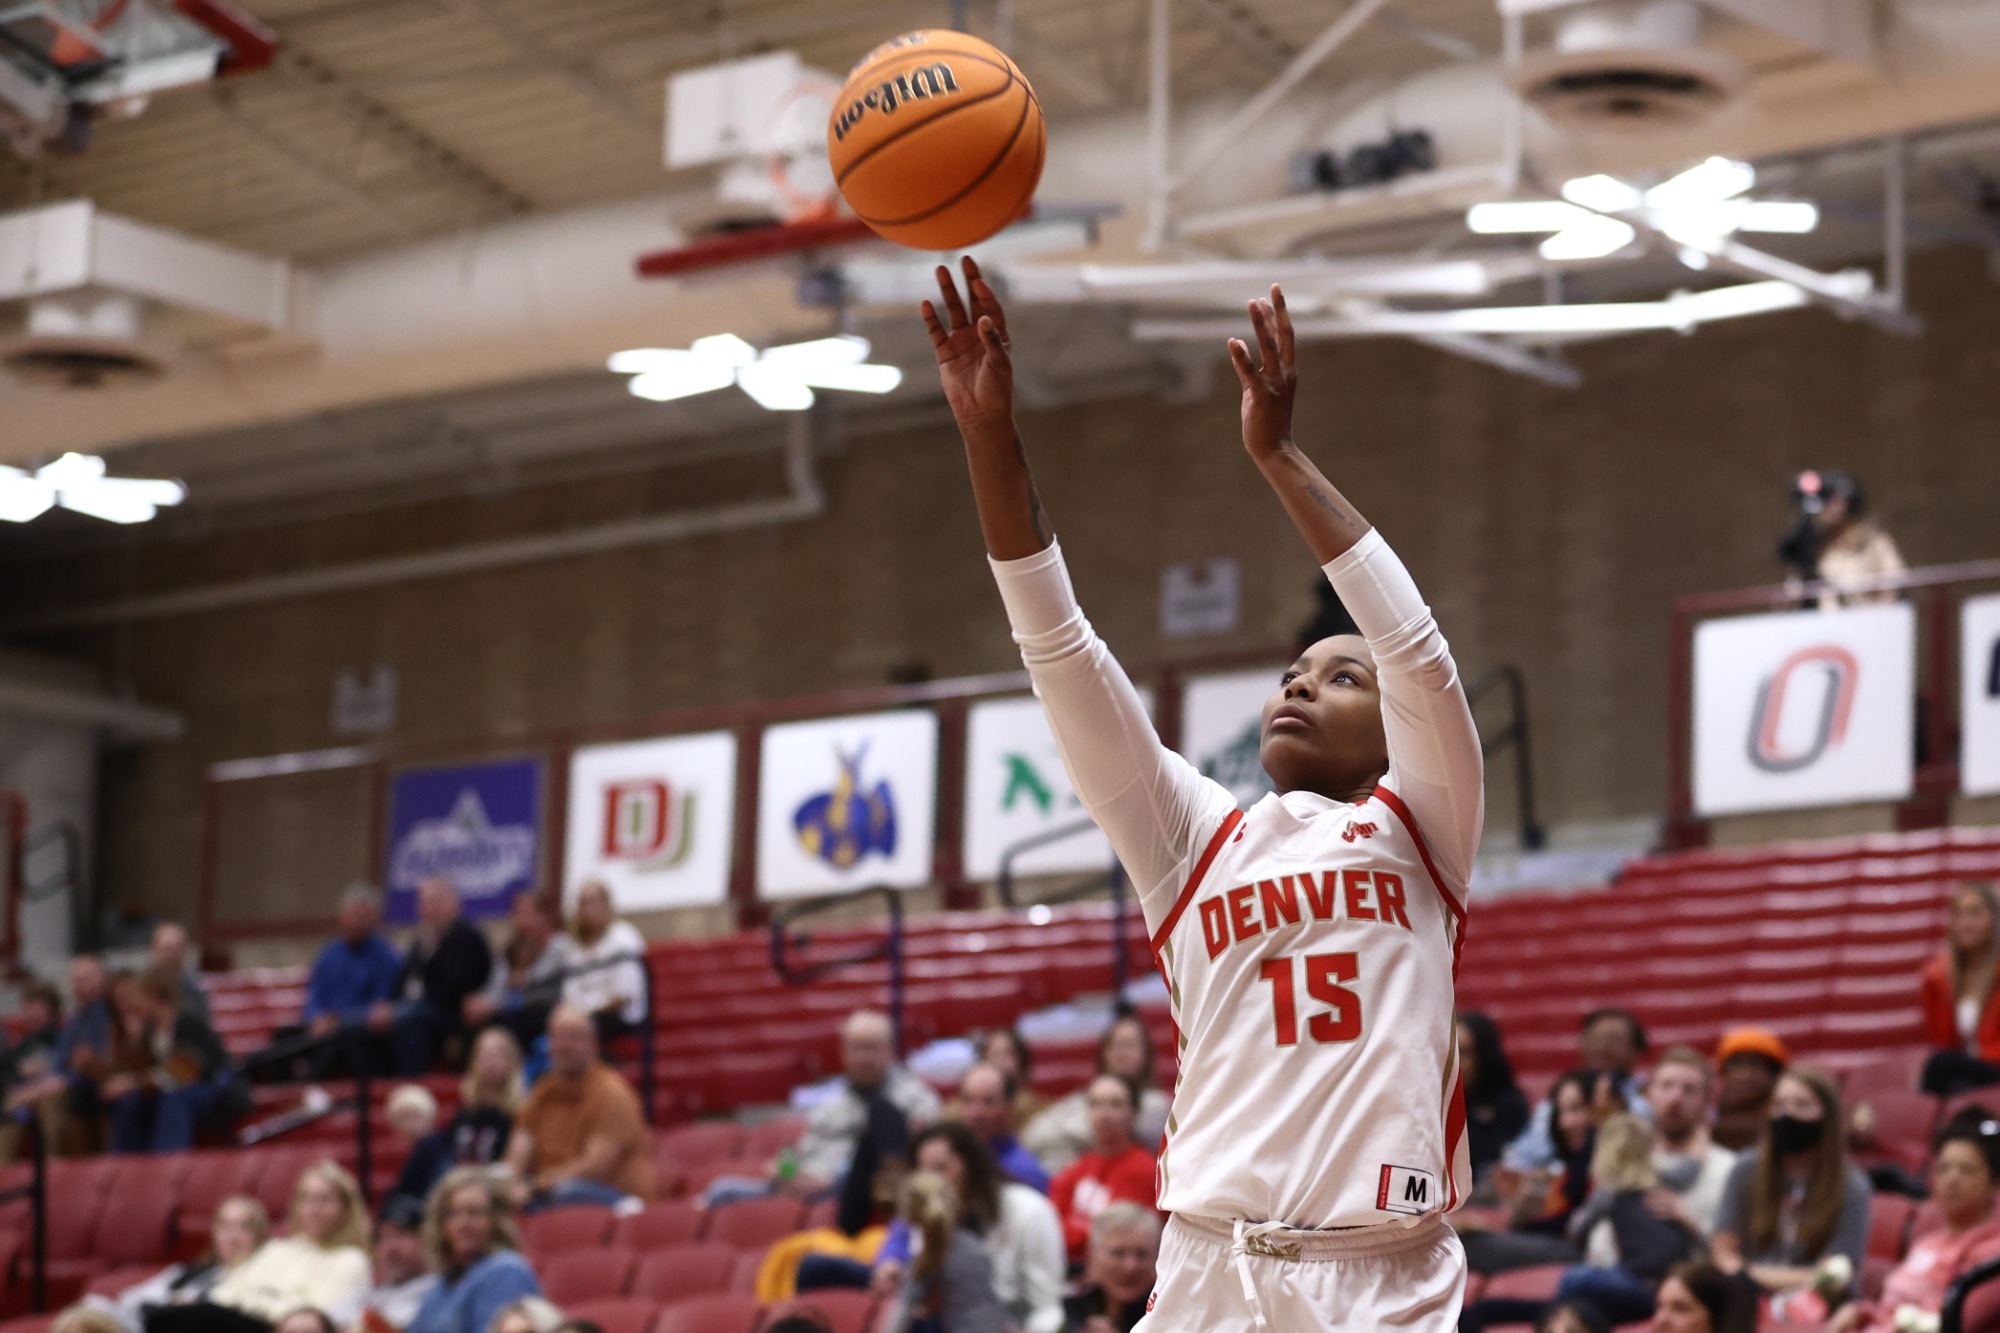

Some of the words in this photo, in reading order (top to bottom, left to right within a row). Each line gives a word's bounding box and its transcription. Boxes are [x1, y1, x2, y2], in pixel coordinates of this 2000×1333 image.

[834, 62, 961, 141] Wilson
[1198, 868, 1414, 964] DENVER
[1259, 952, 1363, 1048] 15
[1404, 1175, 1427, 1204] M
